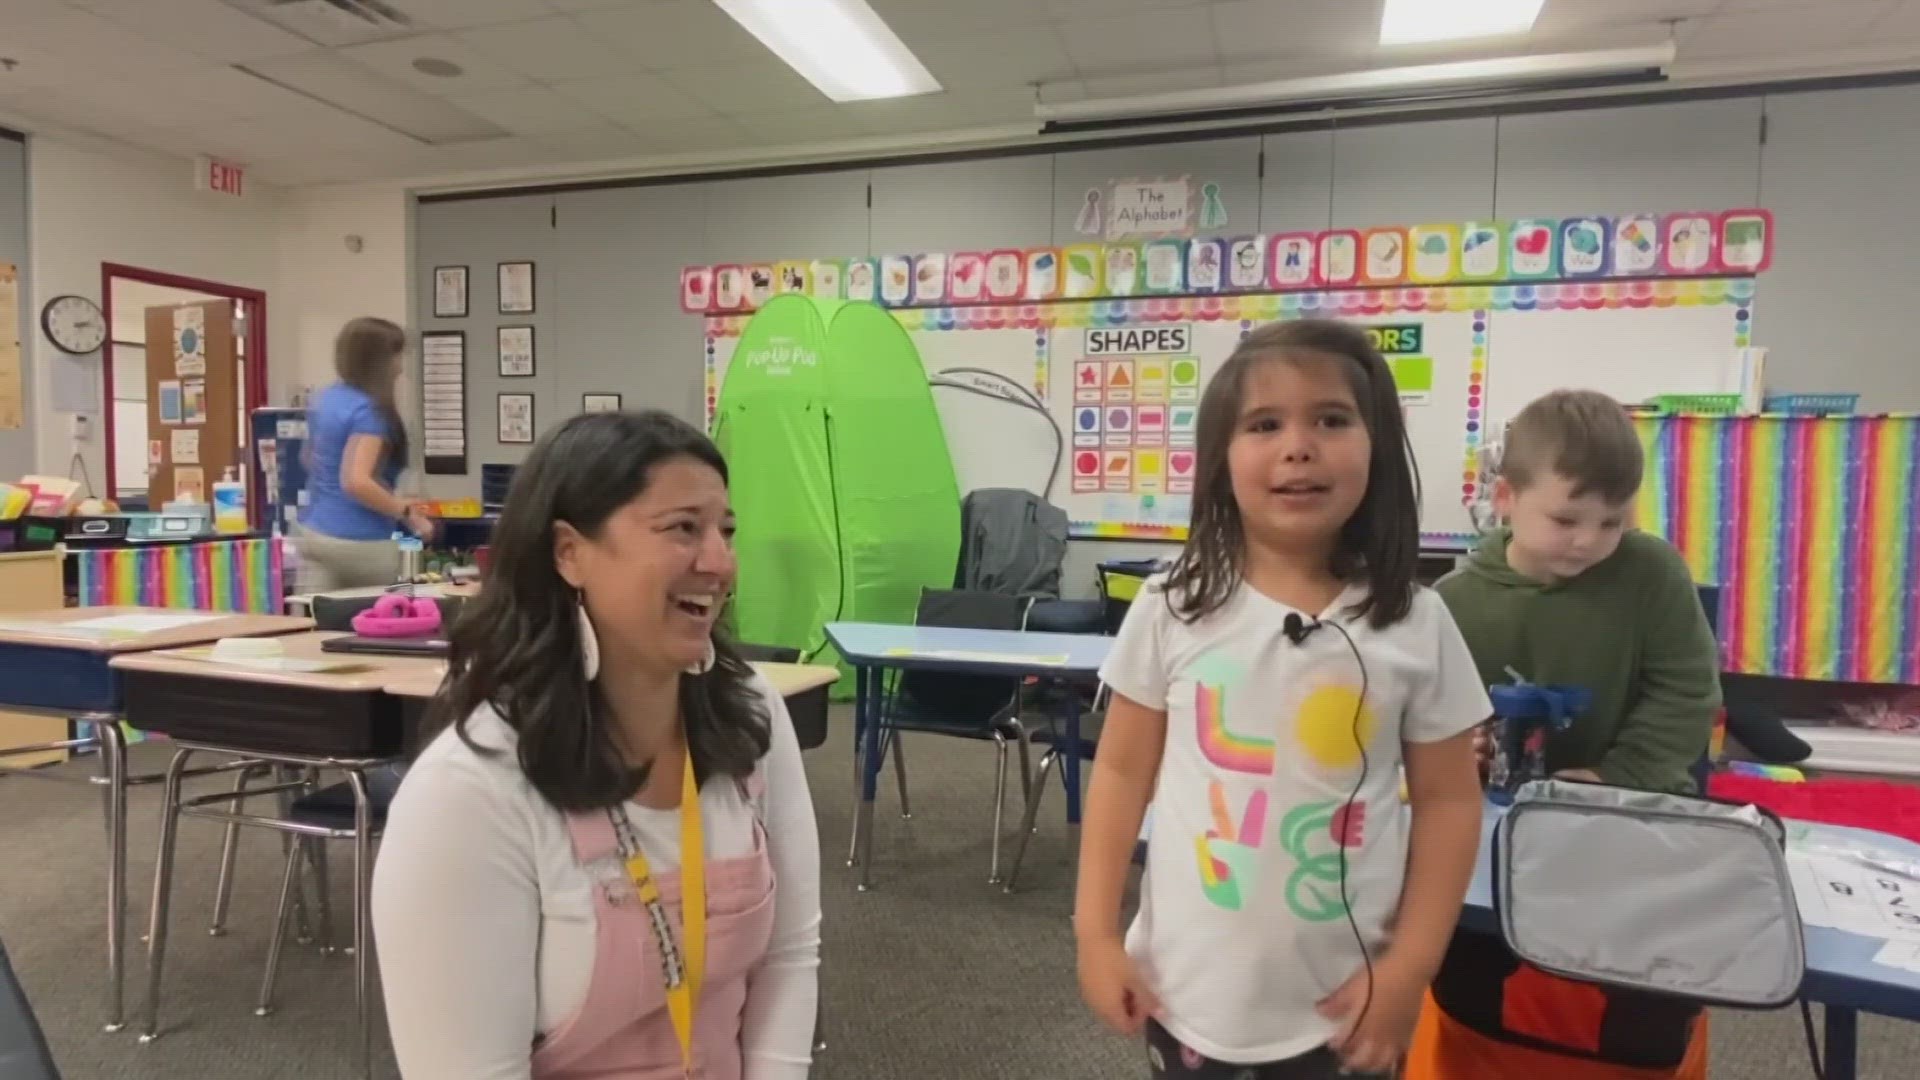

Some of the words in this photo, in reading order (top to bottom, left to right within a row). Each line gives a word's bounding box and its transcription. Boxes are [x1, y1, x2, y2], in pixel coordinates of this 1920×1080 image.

[210, 162, 243, 196] EXIT
[1137, 187, 1165, 203] The
[1118, 206, 1182, 228] Alphabet
[1089, 329, 1186, 352] SHAPES
